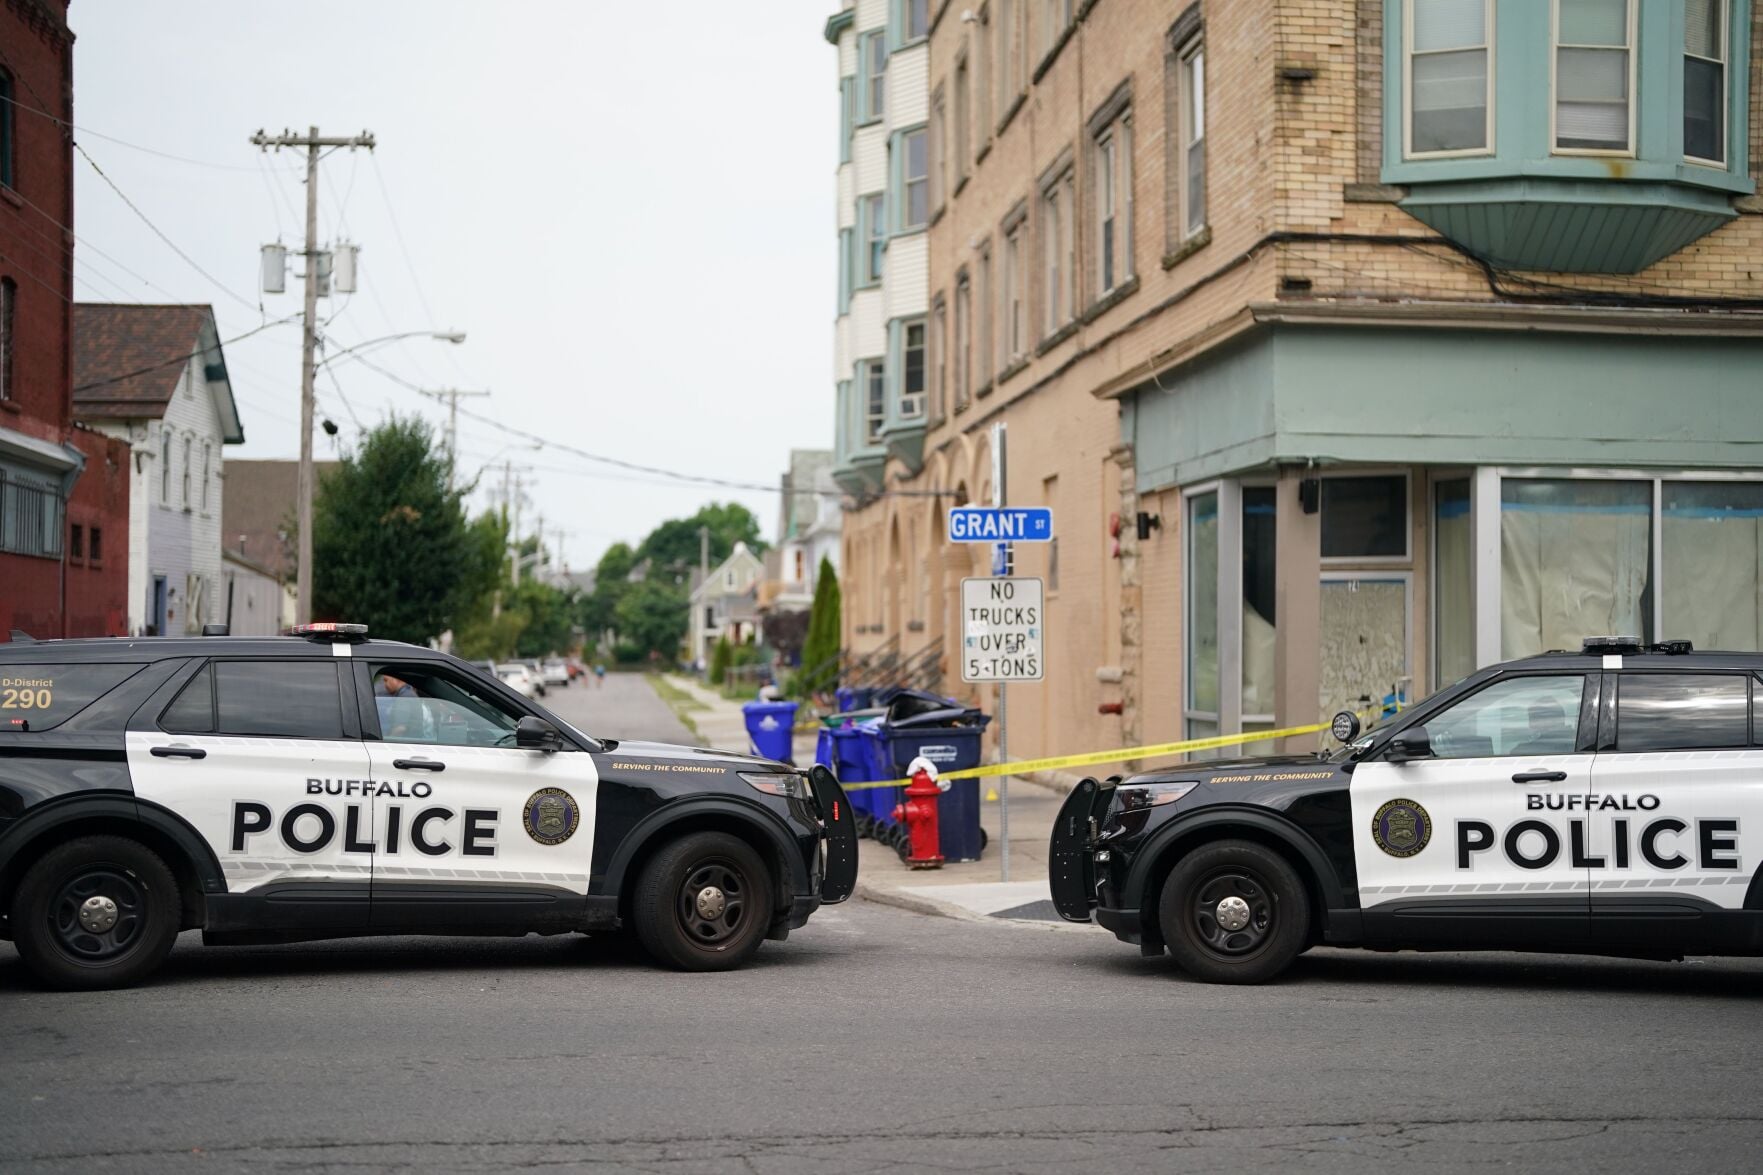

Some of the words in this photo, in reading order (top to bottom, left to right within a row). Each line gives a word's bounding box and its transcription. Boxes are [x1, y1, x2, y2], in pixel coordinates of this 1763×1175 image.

[951, 512, 1028, 537] GRANT
[1034, 519, 1045, 530] ST
[991, 582, 1015, 600] NO
[970, 607, 1037, 625] TRUCKS
[980, 633, 1026, 651] OVER
[970, 658, 980, 677] 5
[990, 658, 1037, 677] TONS
[2, 678, 53, 687] D-District
[2, 688, 52, 709] 290
[612, 762, 651, 771] SERVING
[671, 765, 727, 774] COMMUNITY
[1210, 775, 1251, 784] SERVING
[1253, 774, 1270, 782] THE
[1273, 772, 1334, 781] COMMUNITY
[306, 778, 433, 799] BUFFALO
[548, 788, 566, 799] POLICE
[1397, 799, 1417, 809] POLICE
[1527, 794, 1661, 811] BUFFALO
[231, 801, 498, 857] POLICE
[1456, 818, 1739, 870] POLICE
